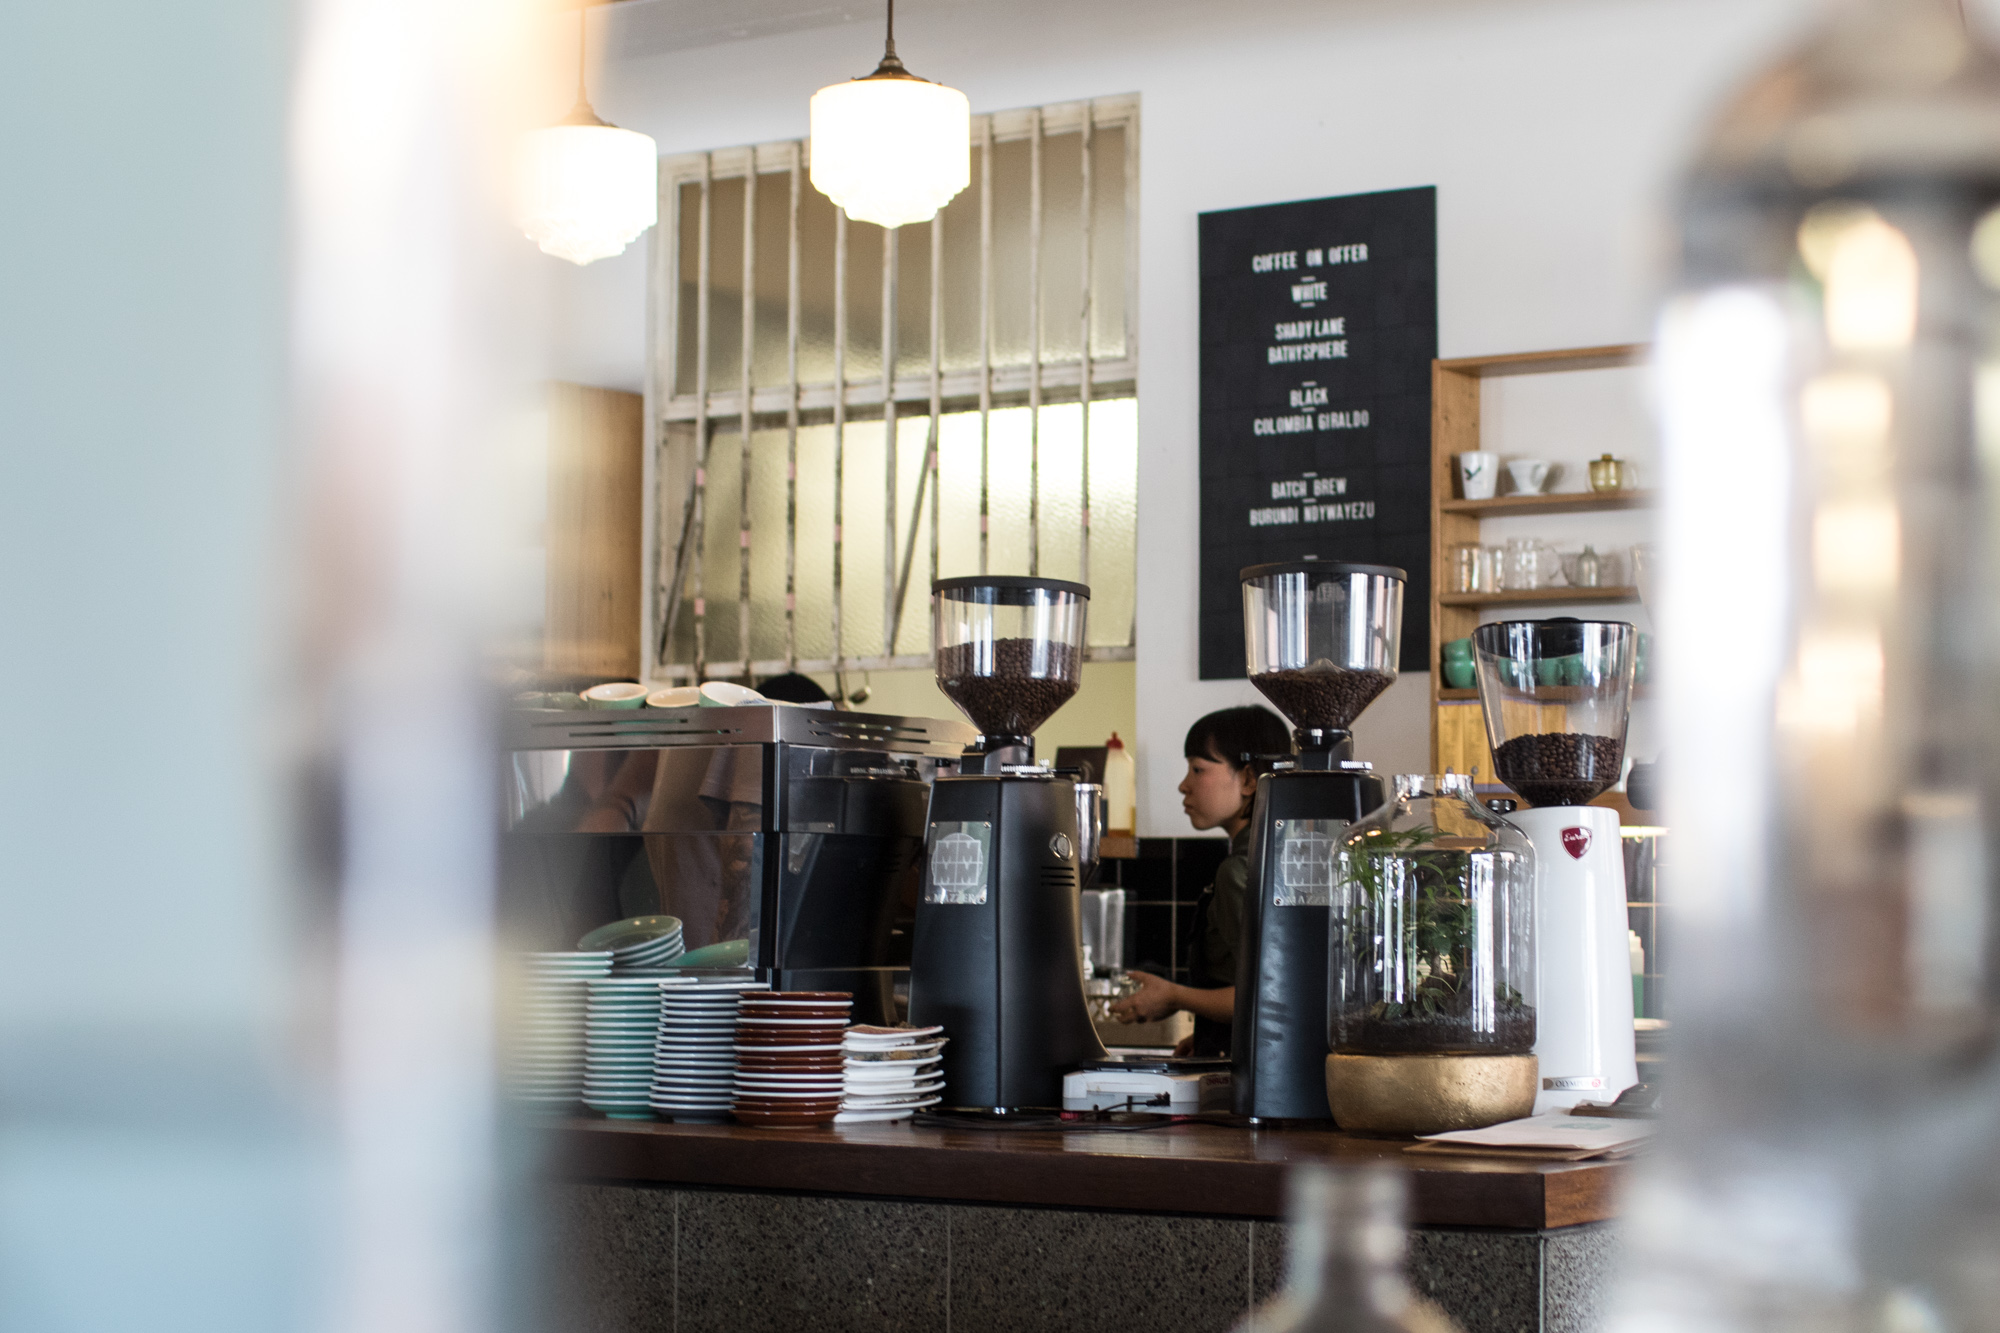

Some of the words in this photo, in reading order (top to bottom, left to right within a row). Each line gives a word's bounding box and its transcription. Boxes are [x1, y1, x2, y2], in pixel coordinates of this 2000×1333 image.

[1252, 251, 1298, 273] COFFEE
[1305, 248, 1324, 267] ON
[1328, 243, 1369, 265] OFFER
[1291, 281, 1328, 303] WHITE
[1275, 320, 1313, 341] SHADY
[1314, 317, 1346, 338] LANE
[1267, 340, 1348, 365] BATHYSPHERE
[1289, 388, 1329, 408] BLACK
[1253, 415, 1314, 436] COLOMBIA
[1317, 410, 1370, 431] GIRALDO
[1271, 481, 1308, 500] BATCH
[1313, 477, 1347, 497] BREW
[1249, 506, 1299, 527] BURUNDI
[1554, 1079, 1590, 1088] OLYMP
